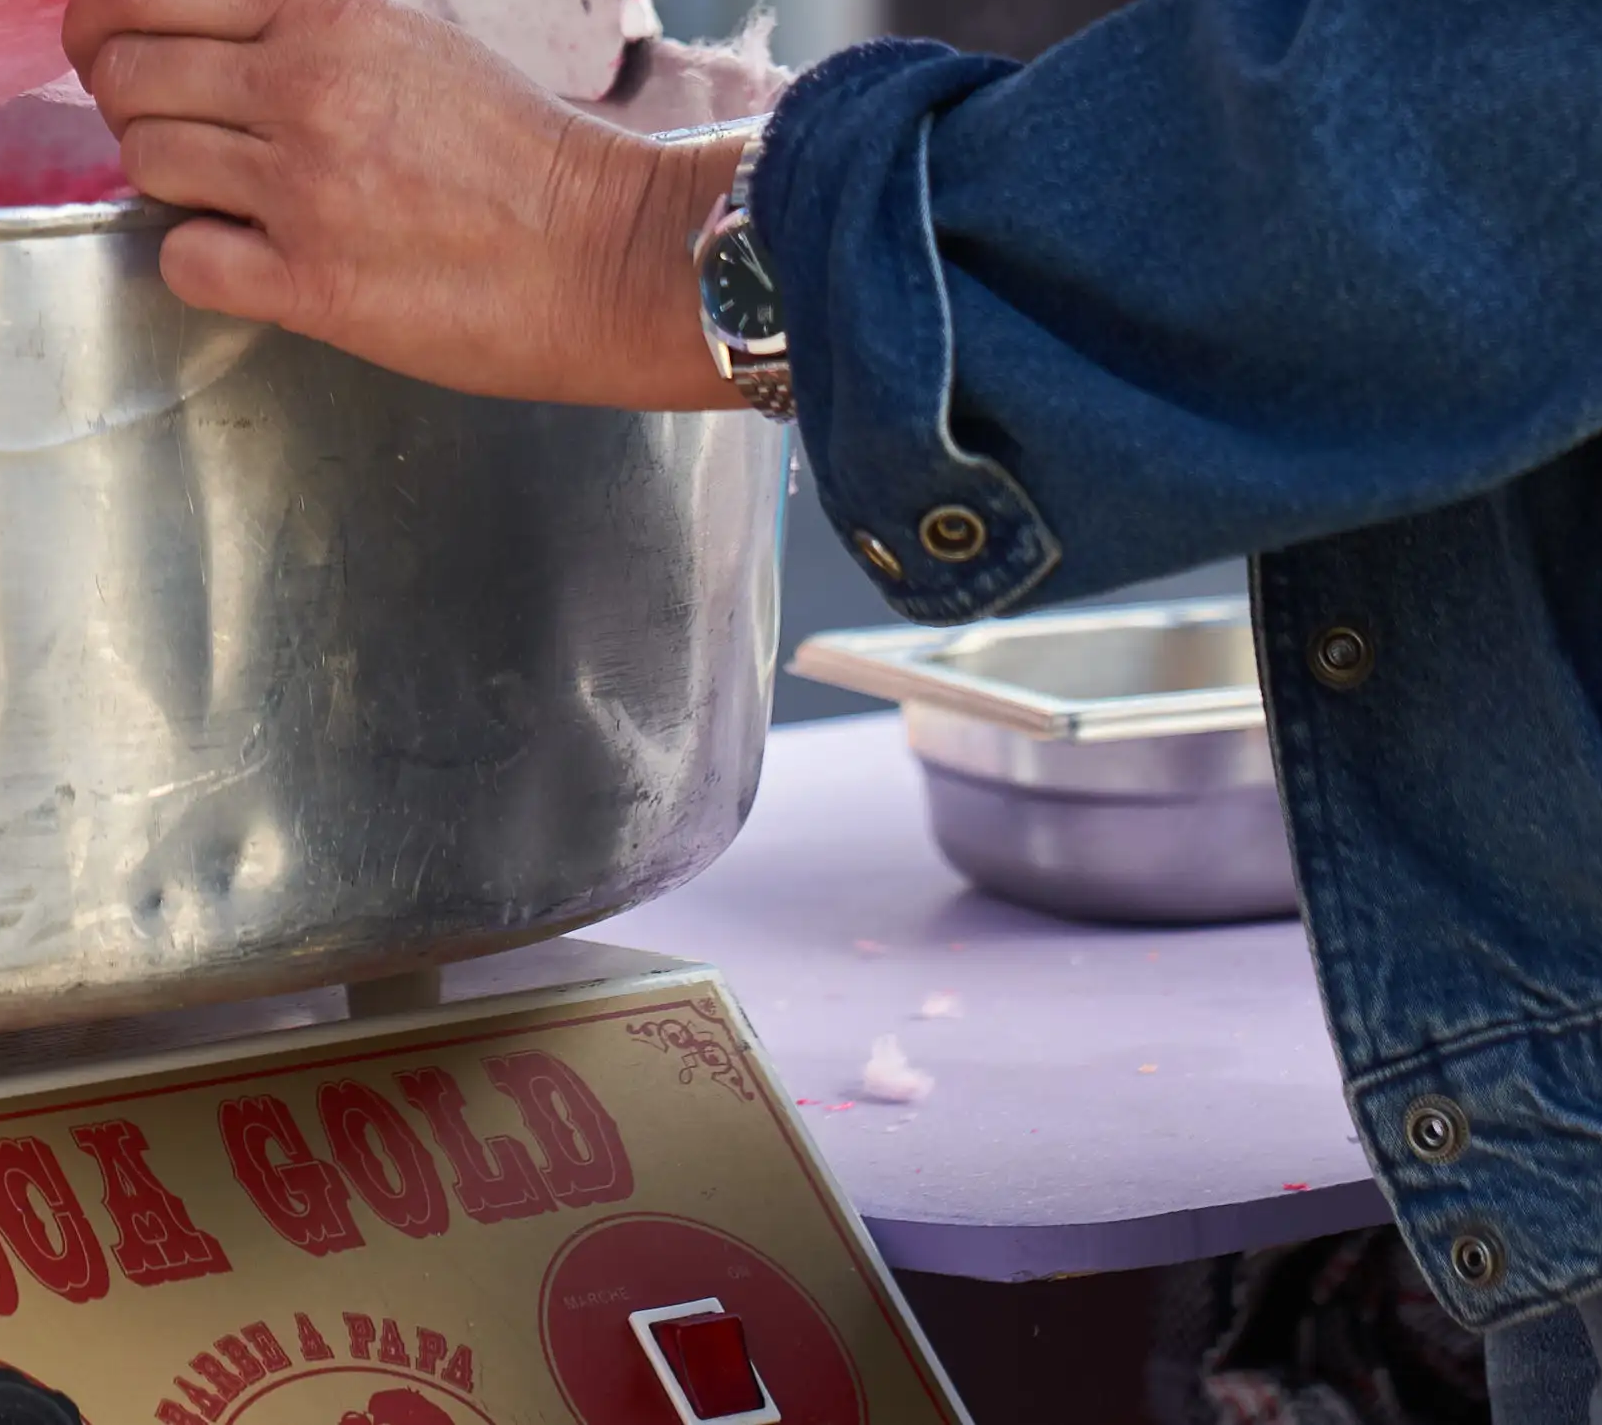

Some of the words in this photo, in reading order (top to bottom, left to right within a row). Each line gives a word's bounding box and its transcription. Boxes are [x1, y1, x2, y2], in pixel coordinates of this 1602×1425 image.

[218, 1049, 635, 1258] GOLD
[294, 1311, 335, 1362] A
[342, 1311, 475, 1394] PAPA
